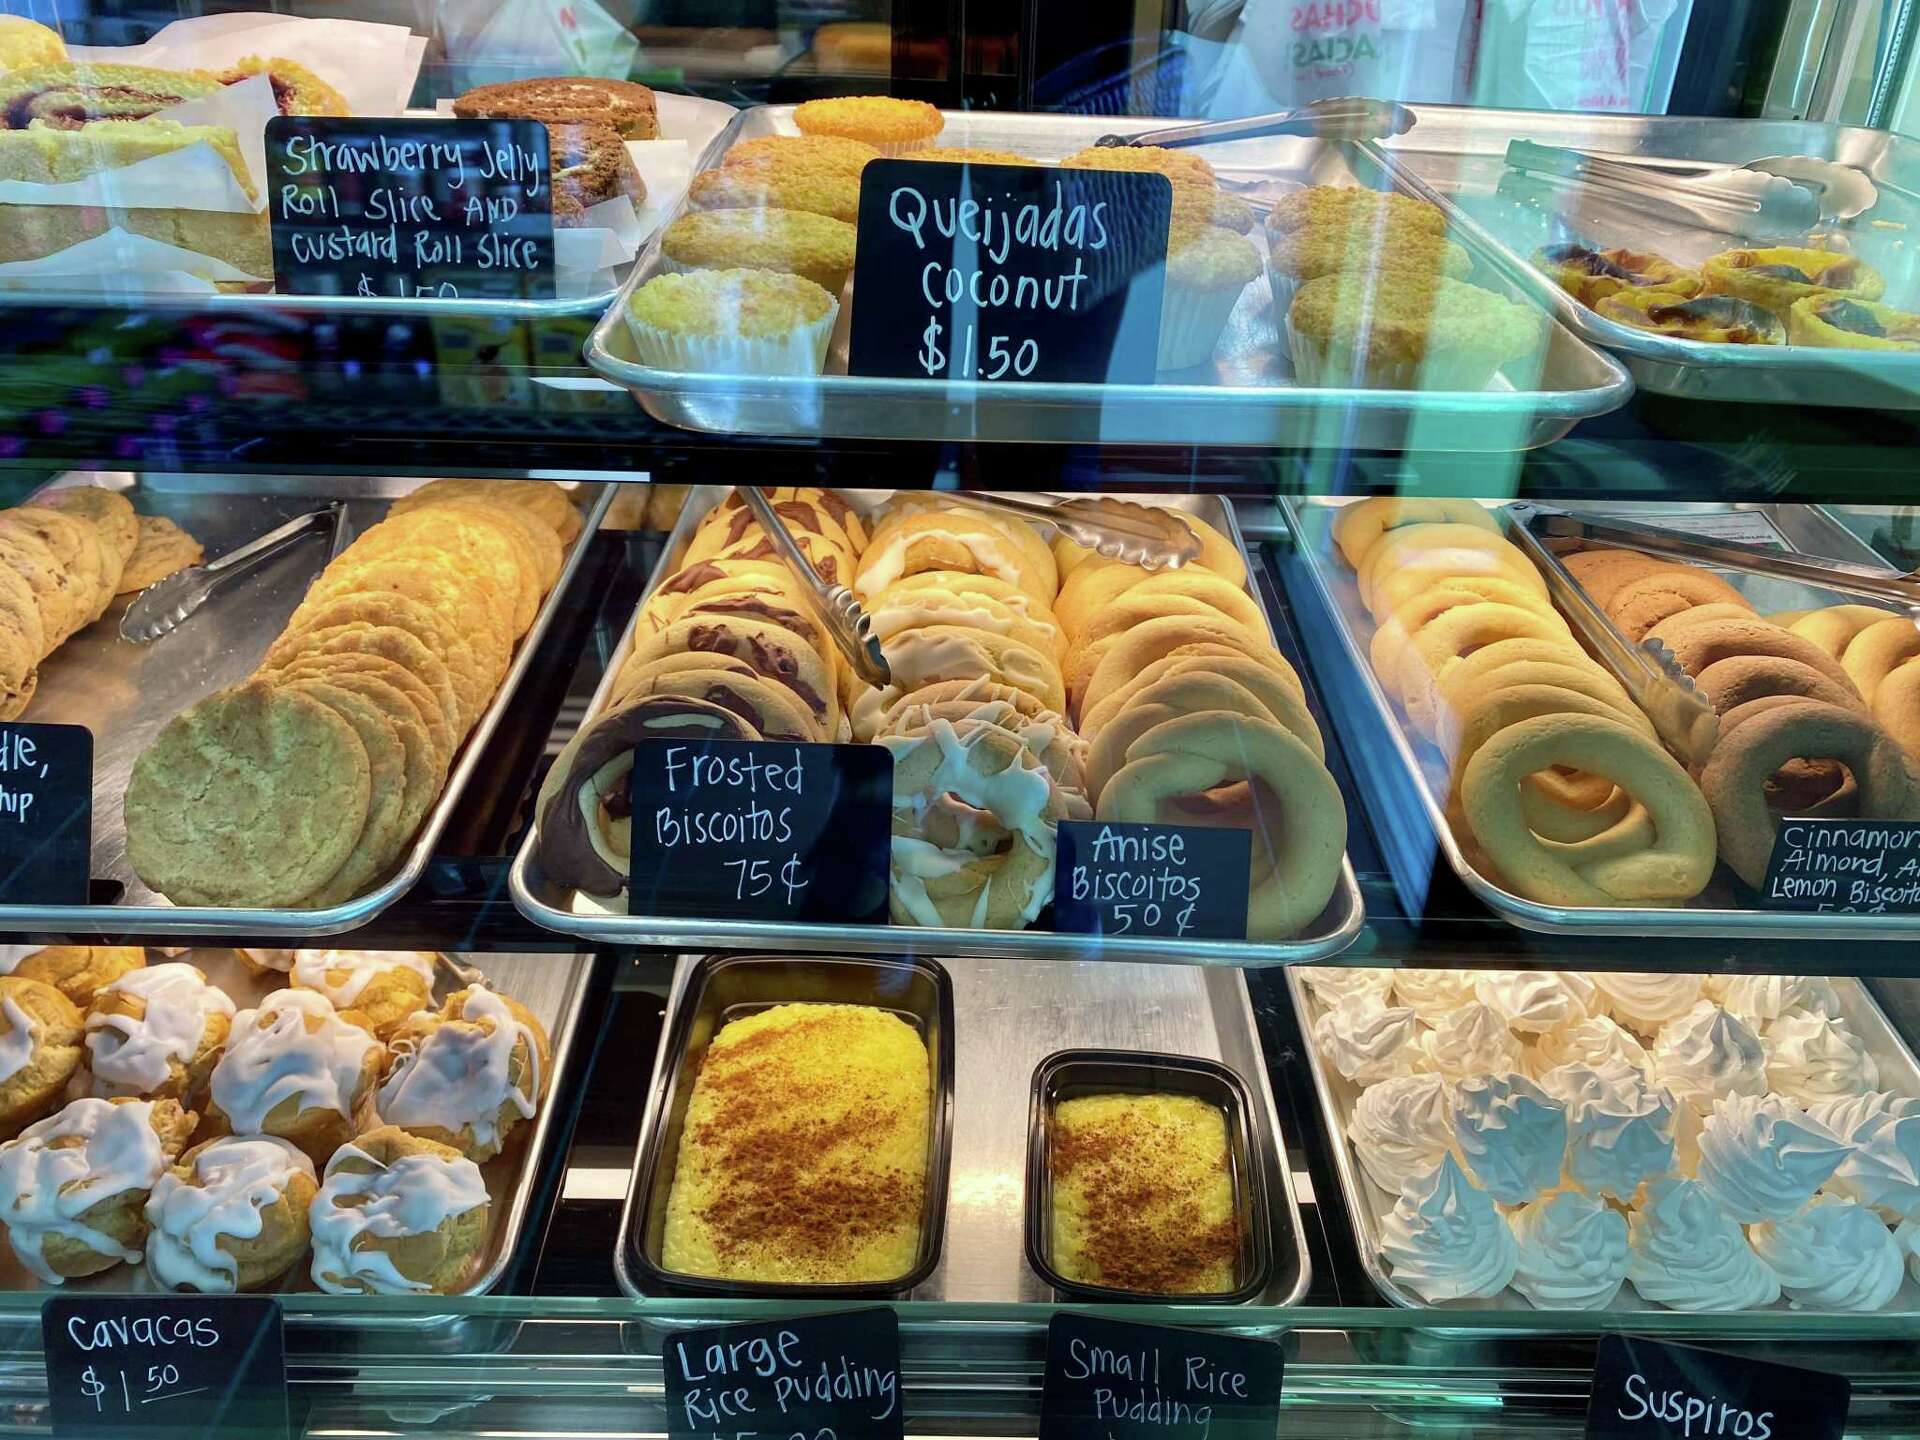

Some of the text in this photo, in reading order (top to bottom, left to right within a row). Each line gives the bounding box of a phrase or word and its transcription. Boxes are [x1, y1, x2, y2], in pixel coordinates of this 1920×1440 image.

[282, 135, 540, 197] Strawberry Jelly
[281, 184, 519, 226] Roll Slice AND
[889, 180, 1107, 264] Queijadas
[413, 230, 462, 268] Roll
[477, 232, 539, 269] Slice
[665, 746, 804, 795] Frosted
[655, 800, 793, 847] Biscoitos
[1092, 825, 1186, 865] Anise
[1072, 865, 1201, 901] Biscoitos
[1771, 876, 1837, 898] Lemon
[68, 1315, 220, 1350] Cavacas
[676, 1330, 803, 1377] Large
[1064, 1338, 1248, 1398] Small Rice
[684, 1387, 756, 1430] Rice
[1618, 1373, 1775, 1440] Suspiros
